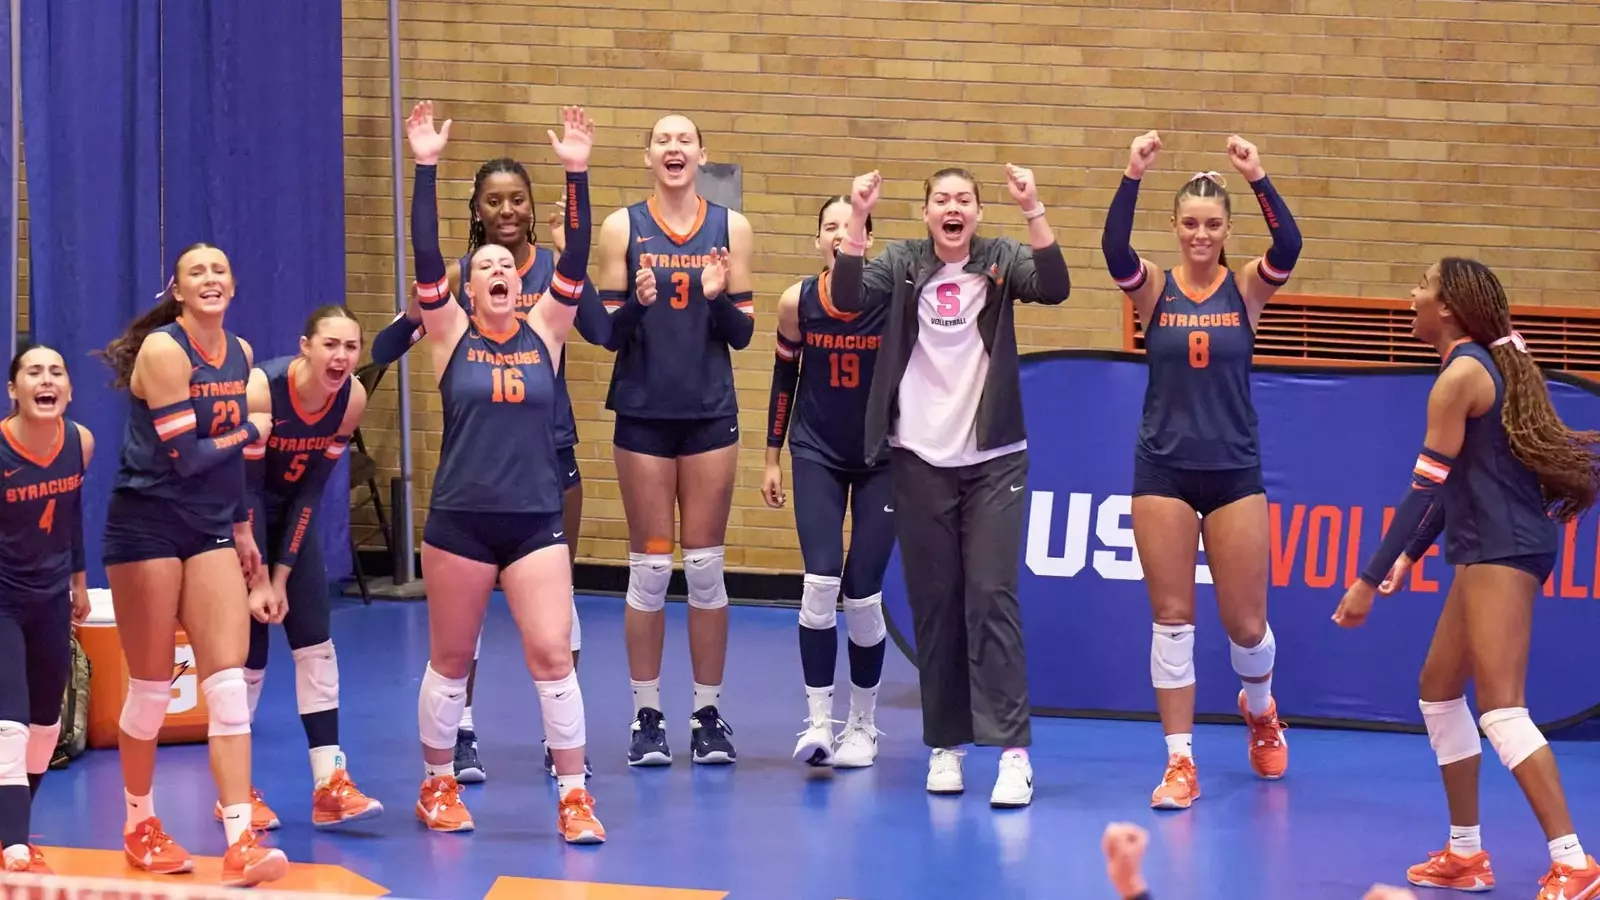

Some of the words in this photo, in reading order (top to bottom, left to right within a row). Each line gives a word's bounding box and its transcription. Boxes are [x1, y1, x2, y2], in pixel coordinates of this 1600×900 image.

[568, 182, 579, 229] SYRACUSE
[1257, 192, 1280, 228] SYRACUSE
[640, 253, 719, 269] SYRACUS
[670, 271, 690, 310] 3
[936, 283, 961, 317] S
[931, 318, 967, 327] VOLLEYBALL
[1159, 312, 1240, 327] SYRACUSE
[467, 348, 541, 366] SYRACUSE
[1188, 330, 1210, 369] 8
[491, 367, 525, 403] 16
[828, 353, 860, 388] 19
[209, 400, 241, 436] 23
[773, 391, 788, 436] ORANGE
[213, 429, 248, 450] ORANGE
[283, 453, 309, 482] 5
[6, 474, 81, 503] SYRACUSE
[39, 498, 56, 535] 4
[288, 507, 312, 554] SYRACUSE
